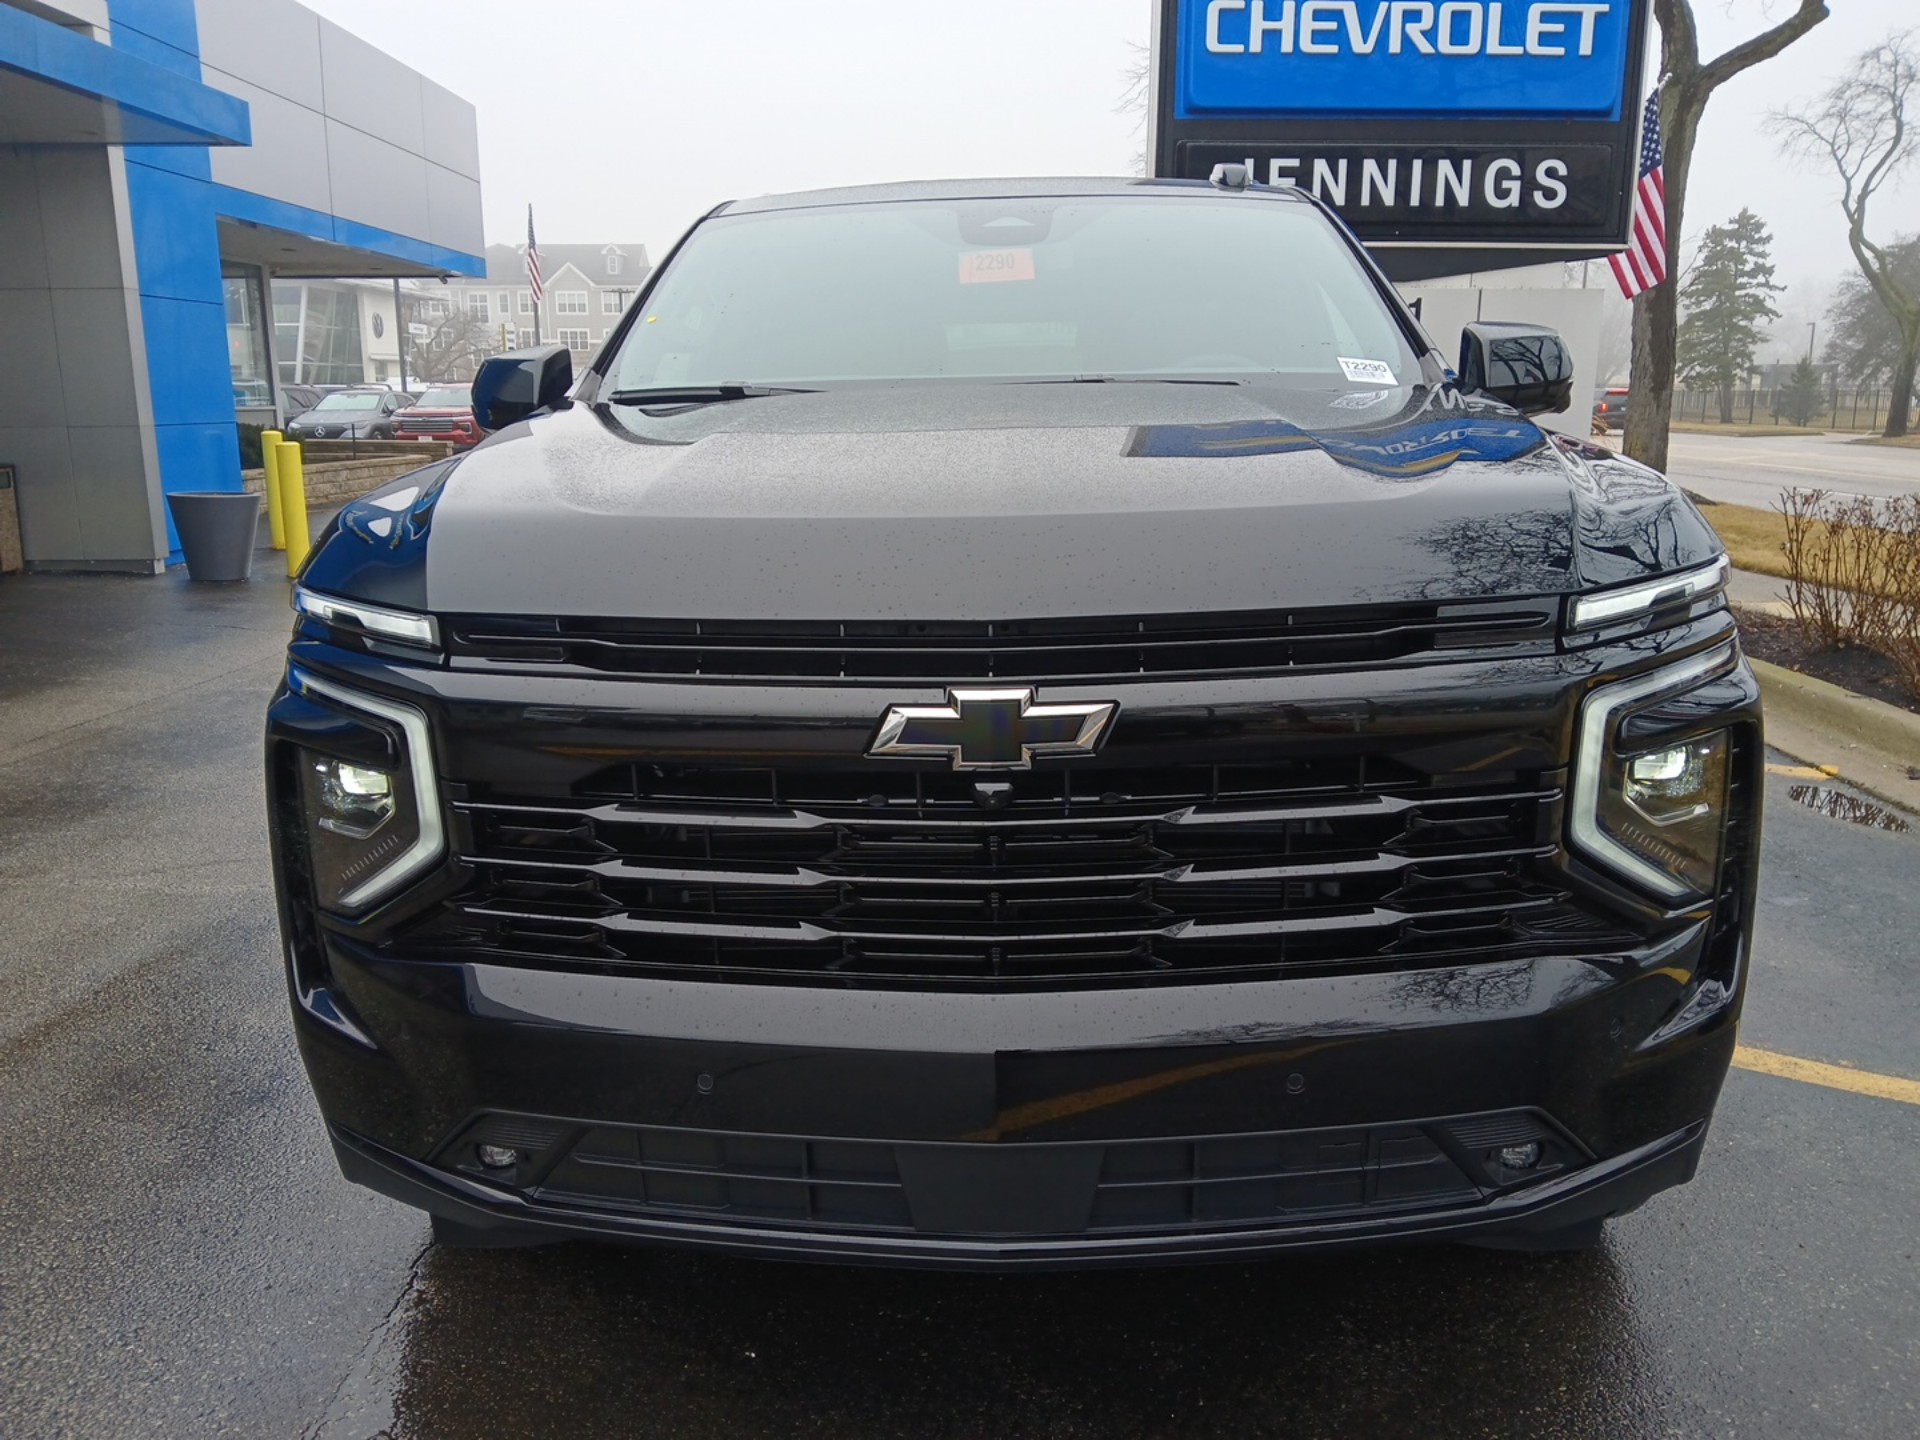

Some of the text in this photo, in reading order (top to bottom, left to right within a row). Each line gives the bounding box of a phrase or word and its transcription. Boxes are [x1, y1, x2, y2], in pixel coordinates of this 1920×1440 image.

[1206, 0, 1610, 56] CHEVROLET
[975, 252, 1016, 271] 2290
[1341, 360, 1387, 372] T2290
